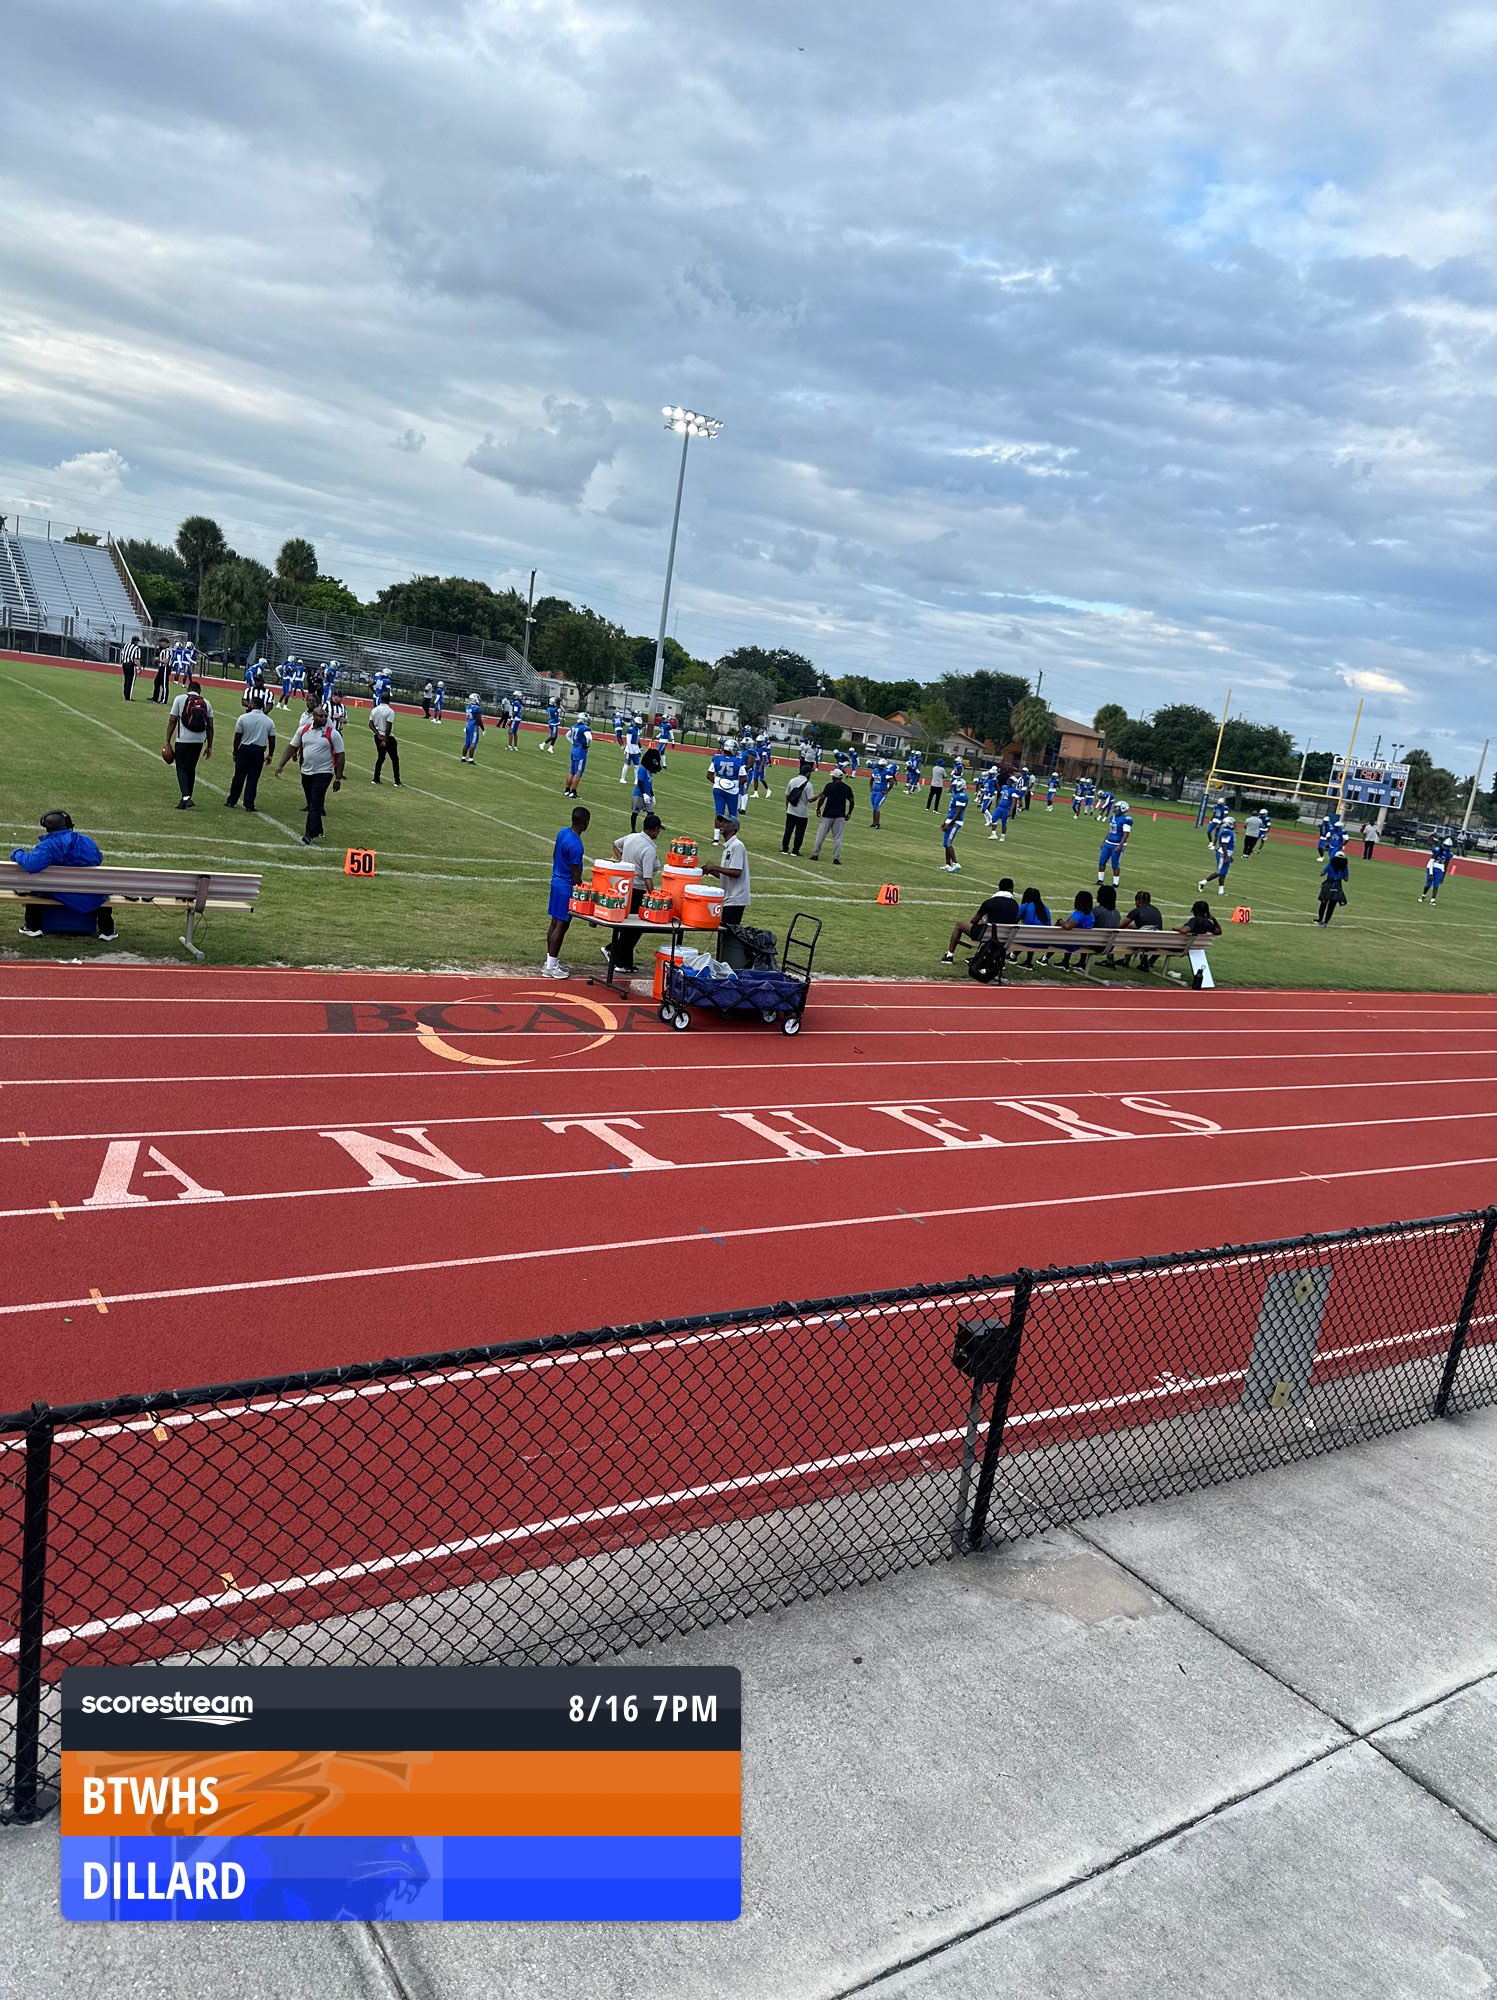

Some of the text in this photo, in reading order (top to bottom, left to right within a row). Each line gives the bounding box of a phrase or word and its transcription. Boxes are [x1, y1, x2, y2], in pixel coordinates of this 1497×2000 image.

[718, 760, 734, 777] 75
[1360, 759, 1377, 769] GRAY
[350, 852, 373, 874] 50
[618, 879, 630, 894] G
[884, 886, 899, 904] 40
[572, 901, 577, 910] G
[714, 904, 721, 915] G
[643, 910, 650, 919] G
[1239, 908, 1250, 923] 30
